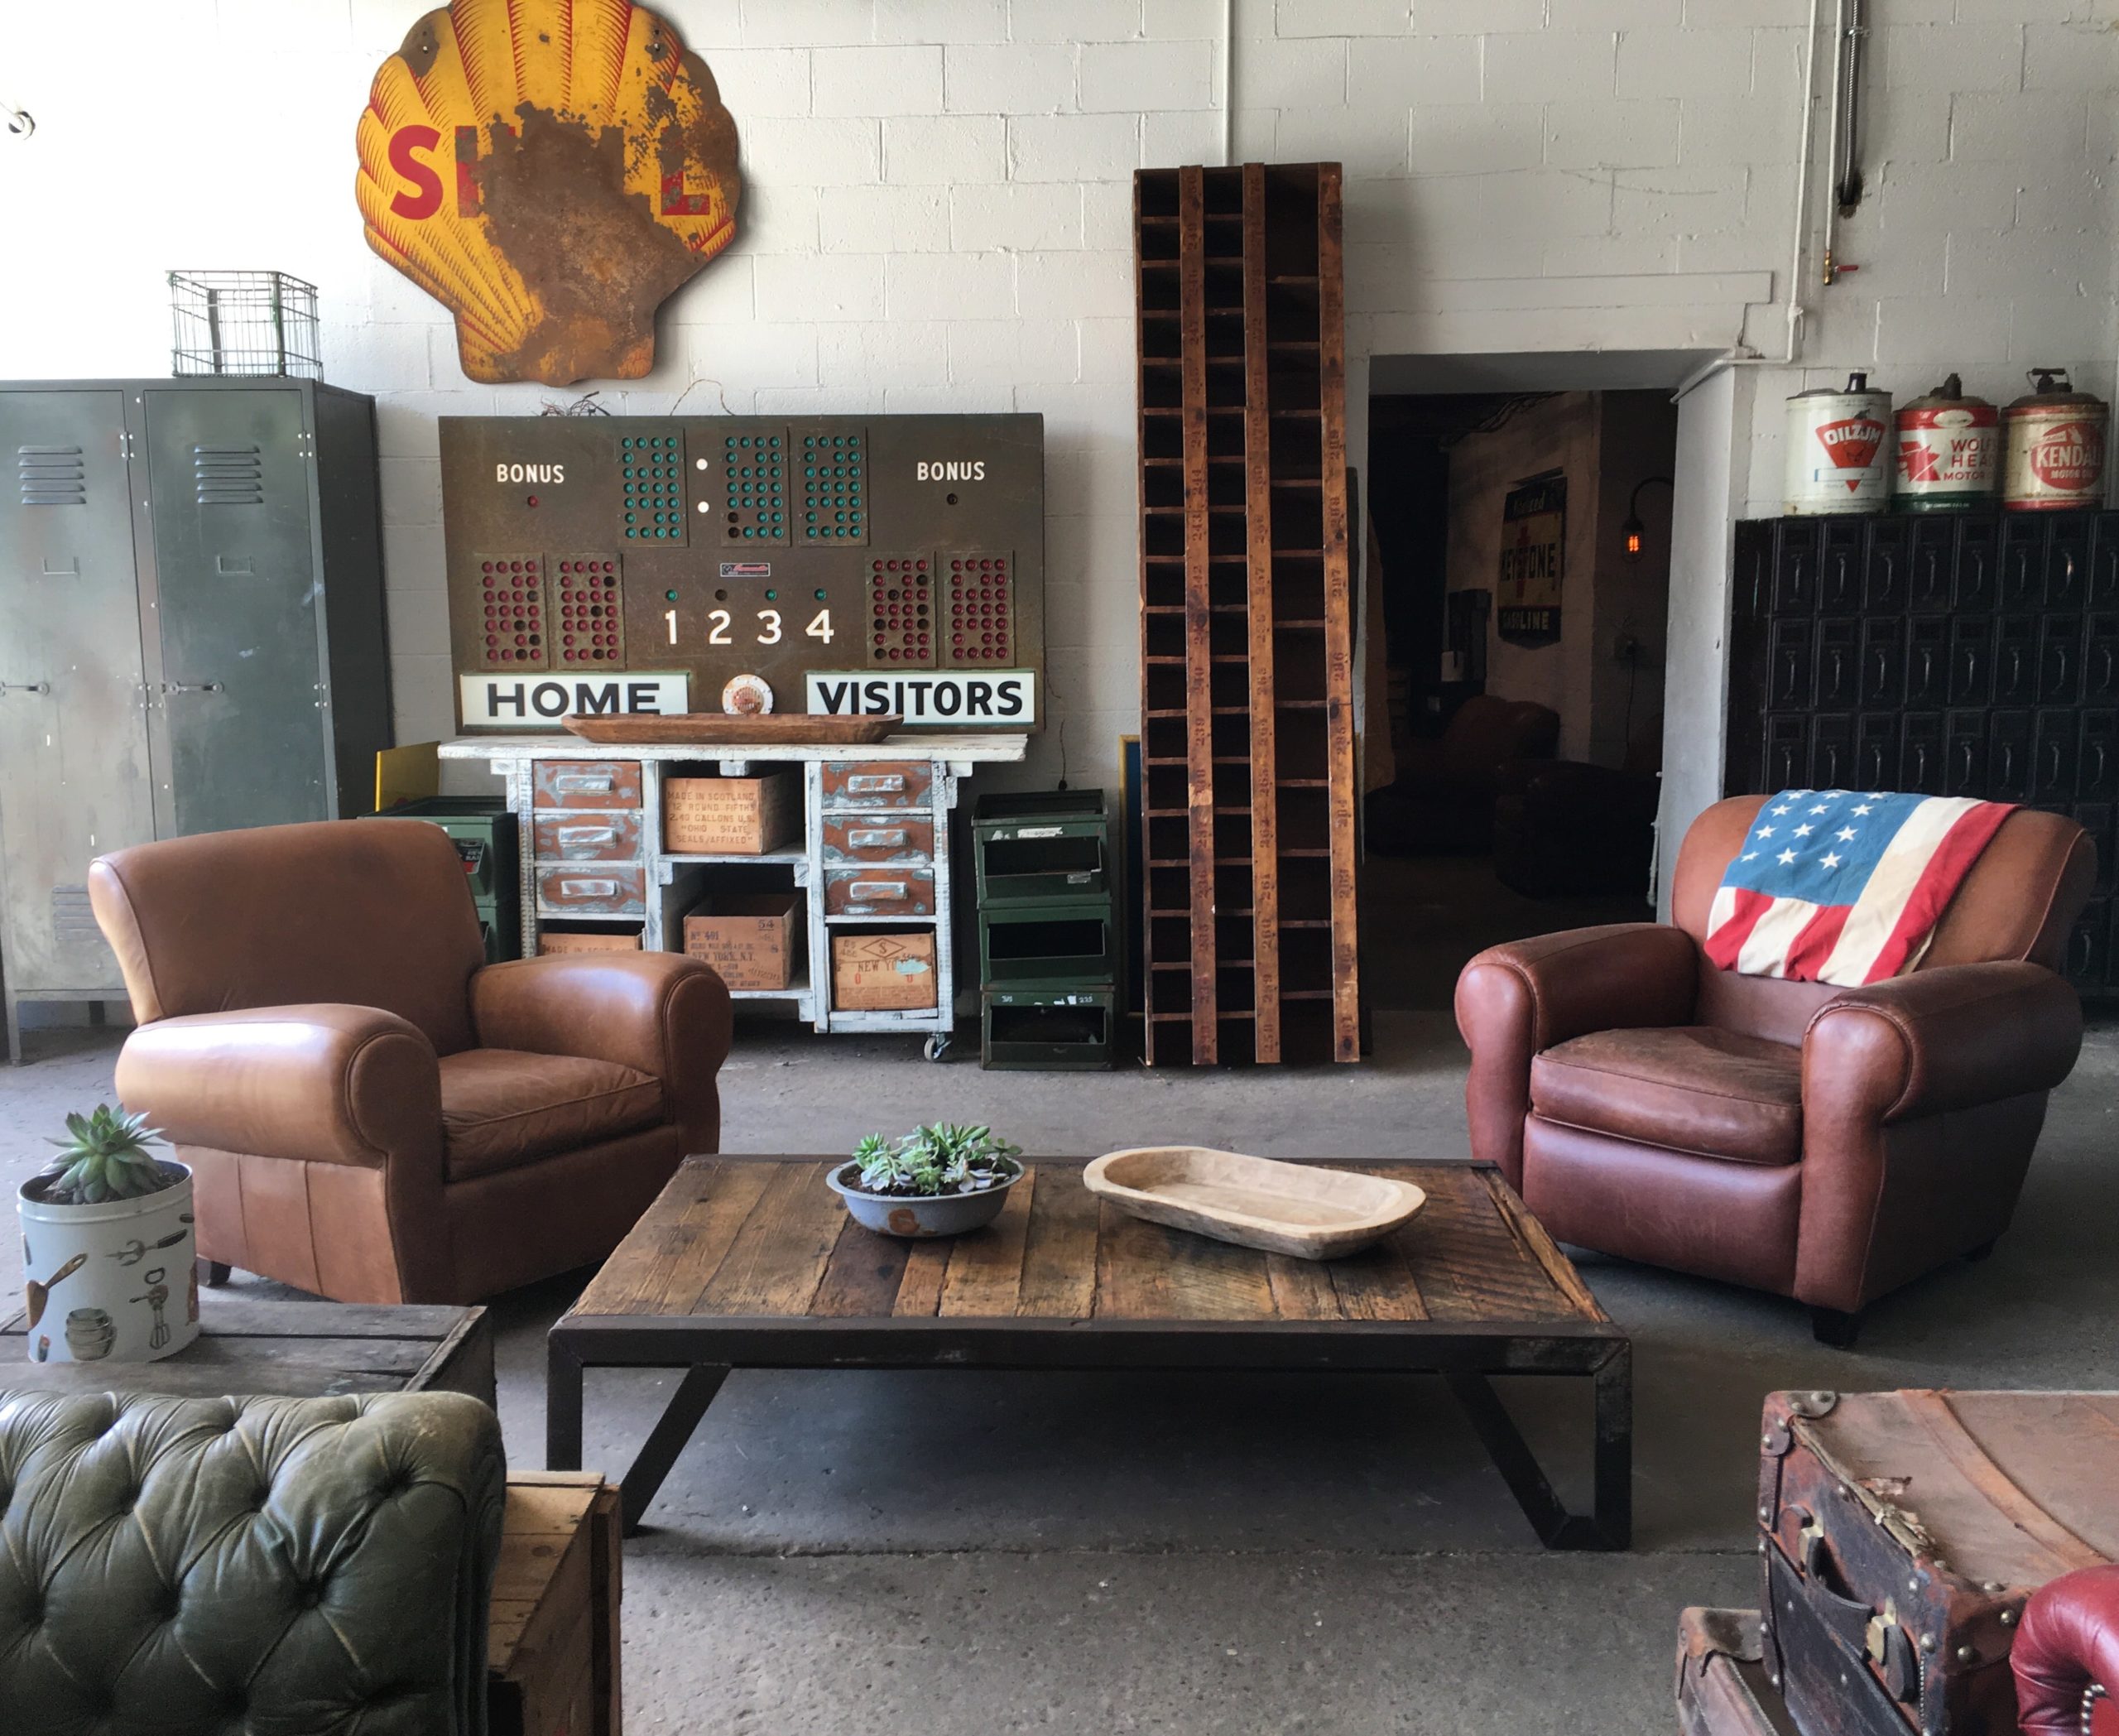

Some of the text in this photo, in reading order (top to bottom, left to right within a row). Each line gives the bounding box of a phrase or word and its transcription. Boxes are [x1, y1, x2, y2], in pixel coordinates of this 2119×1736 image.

[1823, 424, 1881, 445] OILZUM
[497, 464, 565, 483] BONUS
[917, 462, 985, 481] BONUS
[1192, 513, 1202, 541] 243
[665, 609, 834, 644] 1 2 3 4
[1333, 652, 1344, 681] 286
[488, 683, 660, 717] HOME
[817, 681, 1022, 716] VISITORS
[1195, 717, 1205, 747] 239
[667, 791, 691, 801] MADE
[695, 792, 704, 801] IN
[673, 803, 682, 811] 12
[689, 803, 719, 811] ROUND
[694, 814, 734, 822] GALLONS
[1261, 873, 1271, 901] 261
[1261, 917, 1272, 950] 260
[542, 945, 568, 954] MADE
[858, 960, 879, 973] NEW
